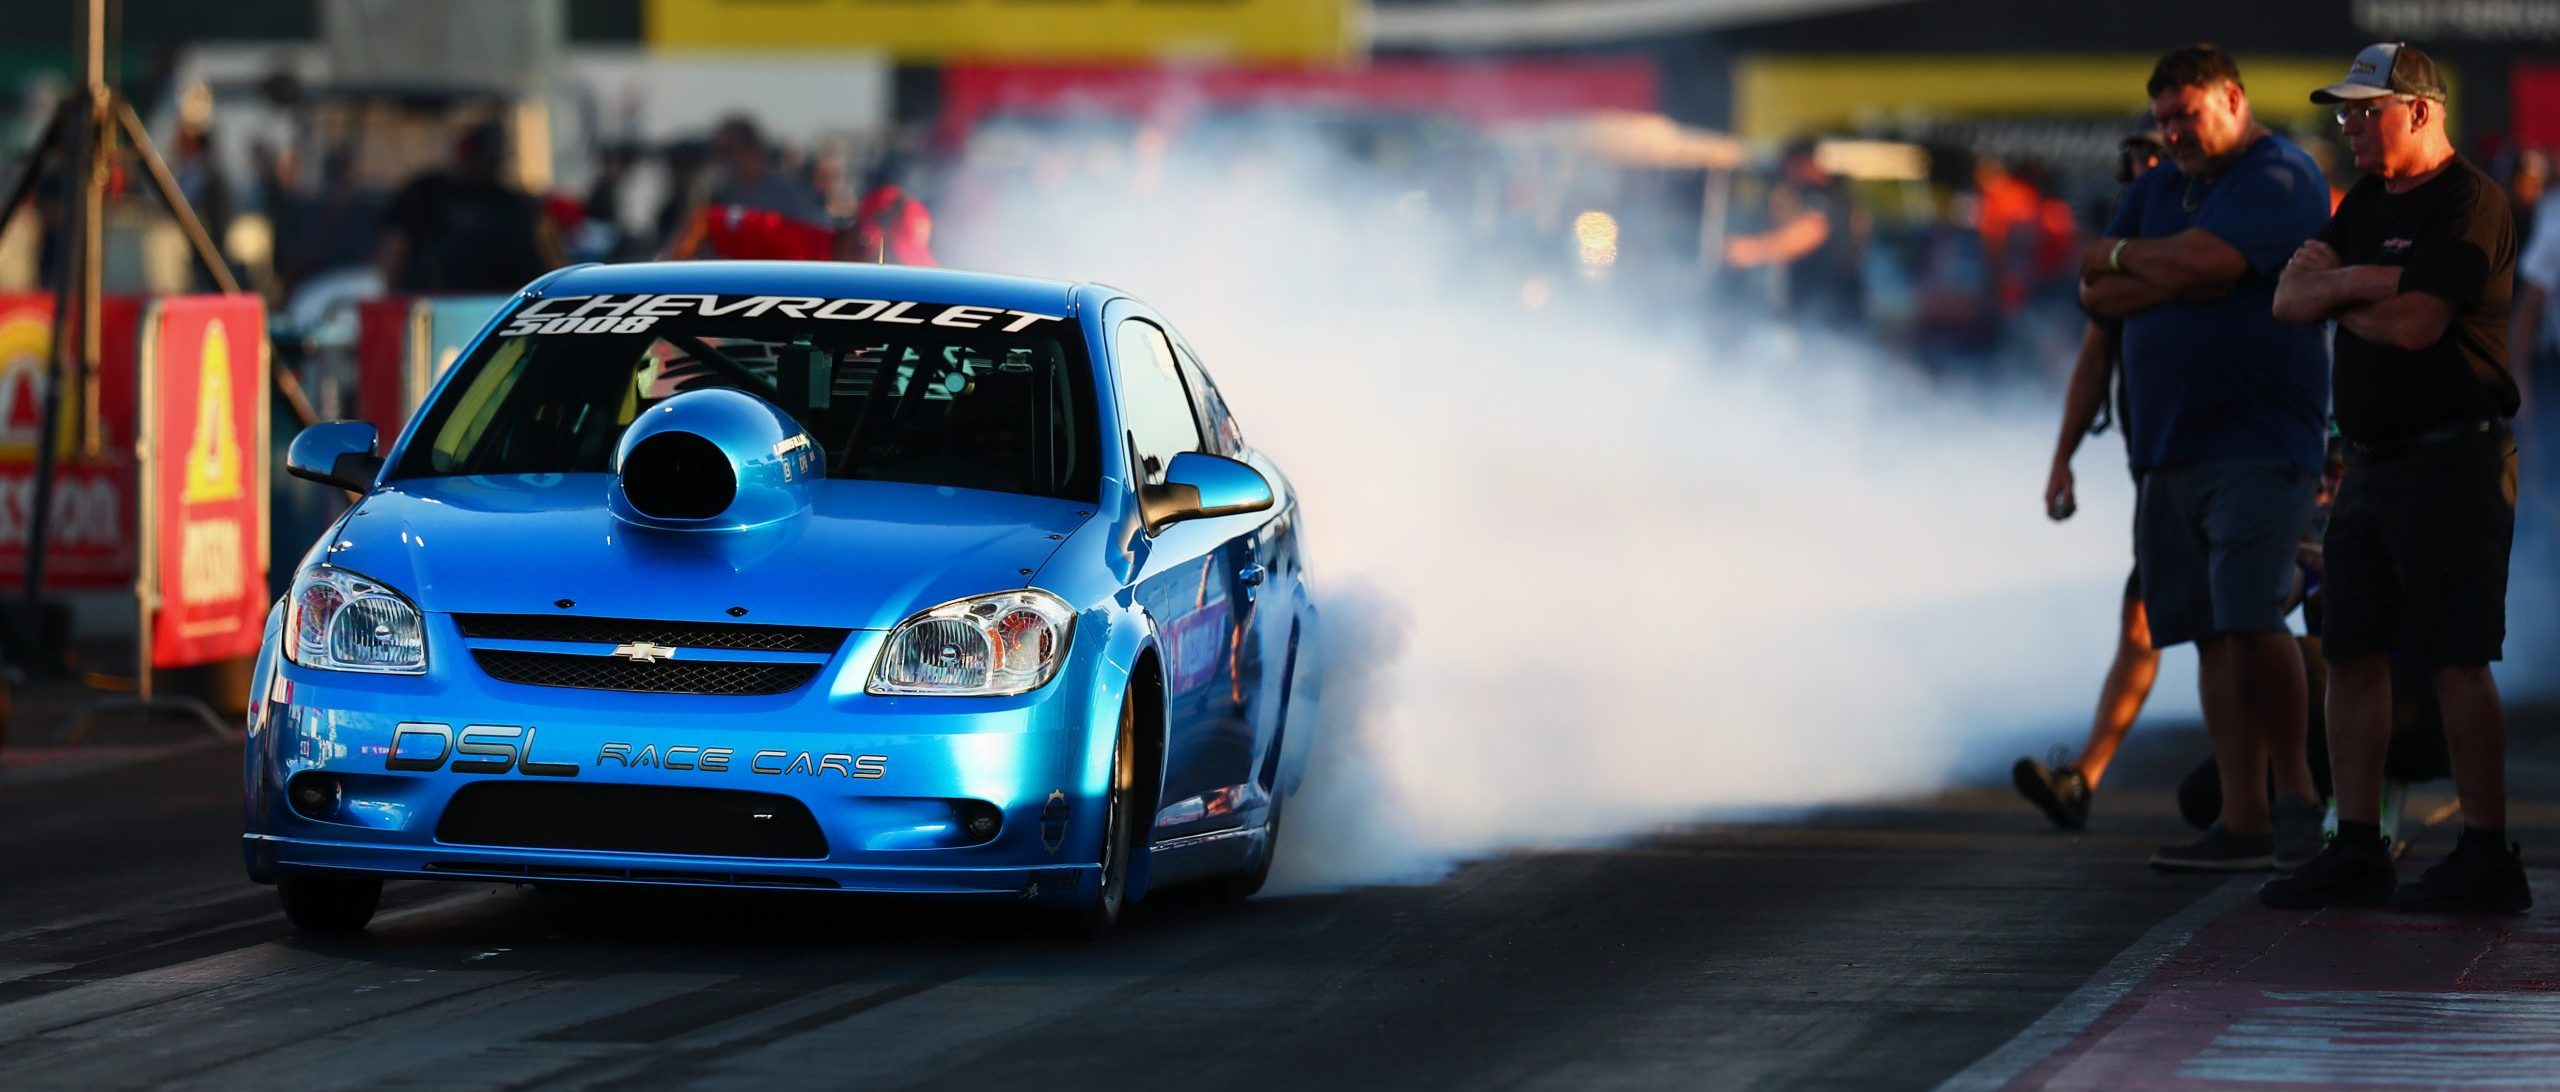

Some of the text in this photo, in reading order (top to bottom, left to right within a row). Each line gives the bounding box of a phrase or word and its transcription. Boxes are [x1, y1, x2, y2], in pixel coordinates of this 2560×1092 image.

[499, 316, 660, 336] 5008
[515, 294, 1065, 333] CHEVROLET
[385, 722, 888, 779] DSL RACE CARS
